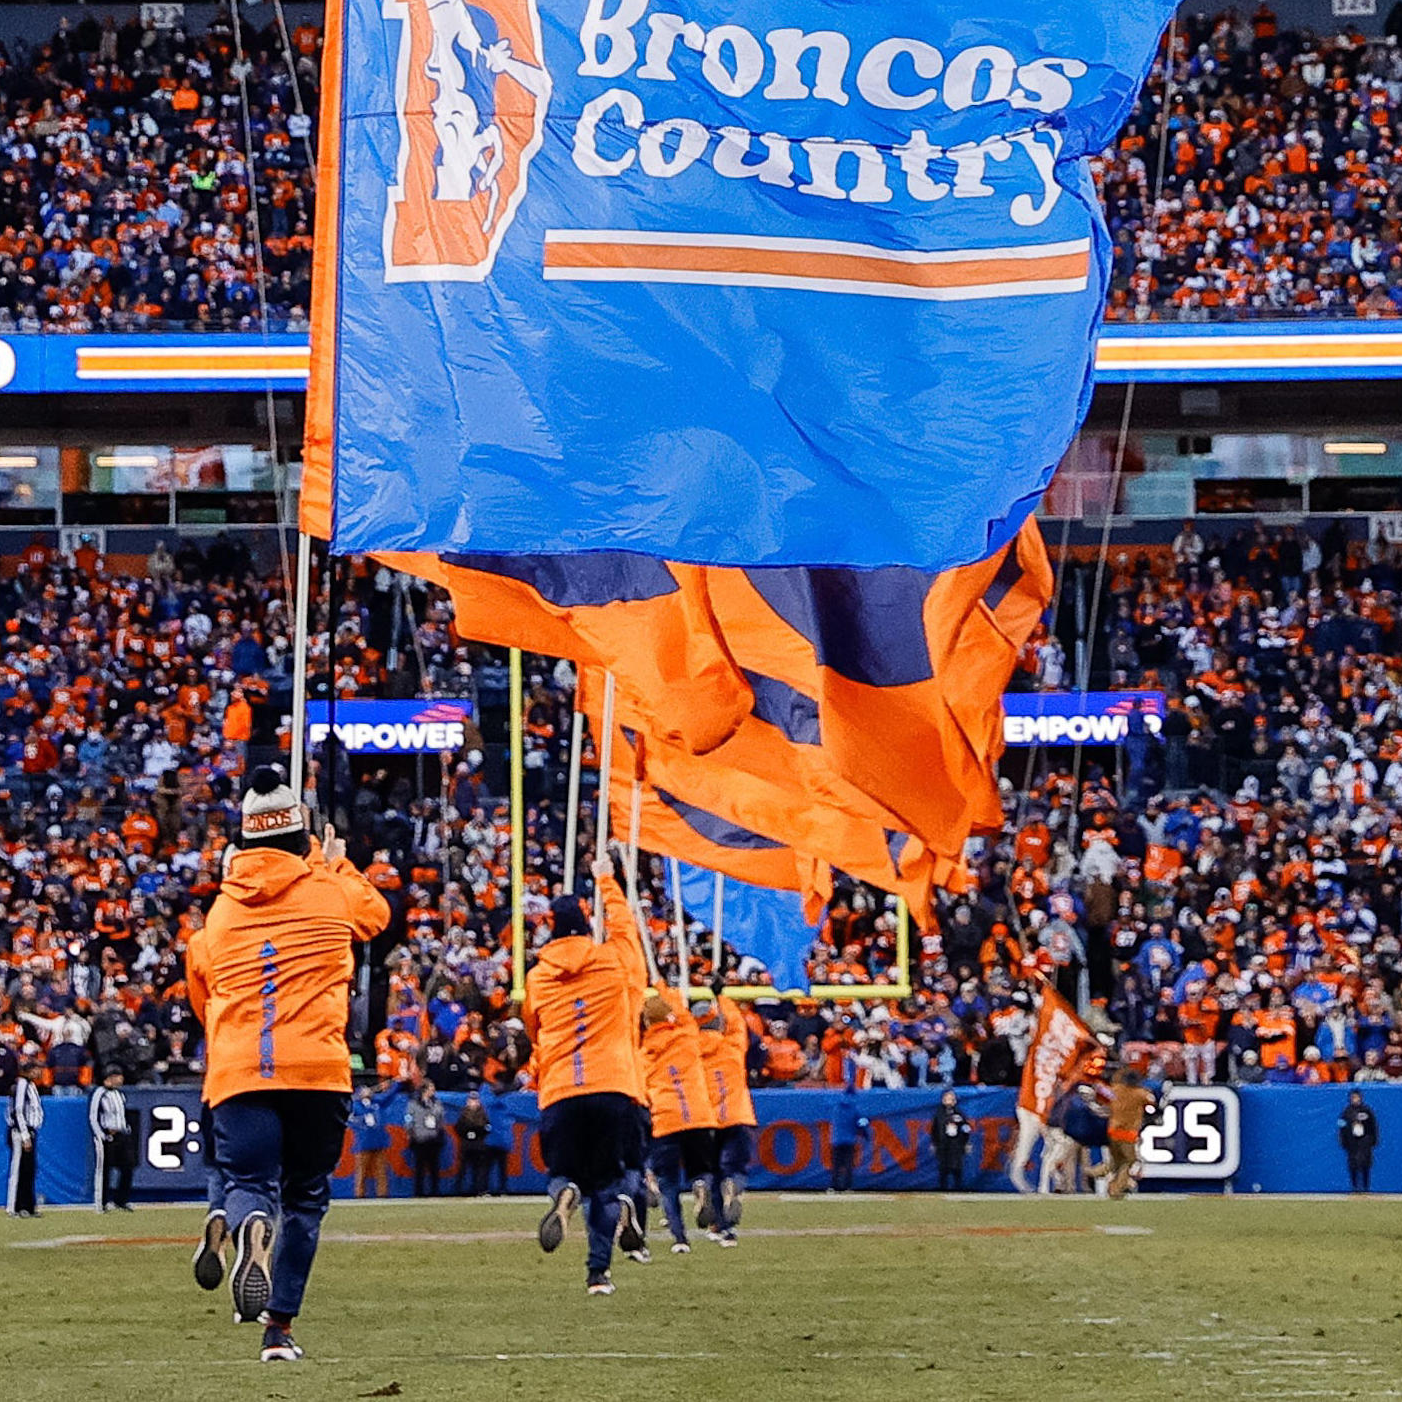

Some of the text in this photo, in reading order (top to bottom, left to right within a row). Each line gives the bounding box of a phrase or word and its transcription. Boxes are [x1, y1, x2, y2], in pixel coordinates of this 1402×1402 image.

[571, 90, 1064, 227] Country
[1003, 715, 1162, 742] EMPOWR
[1141, 1101, 1221, 1163] 25
